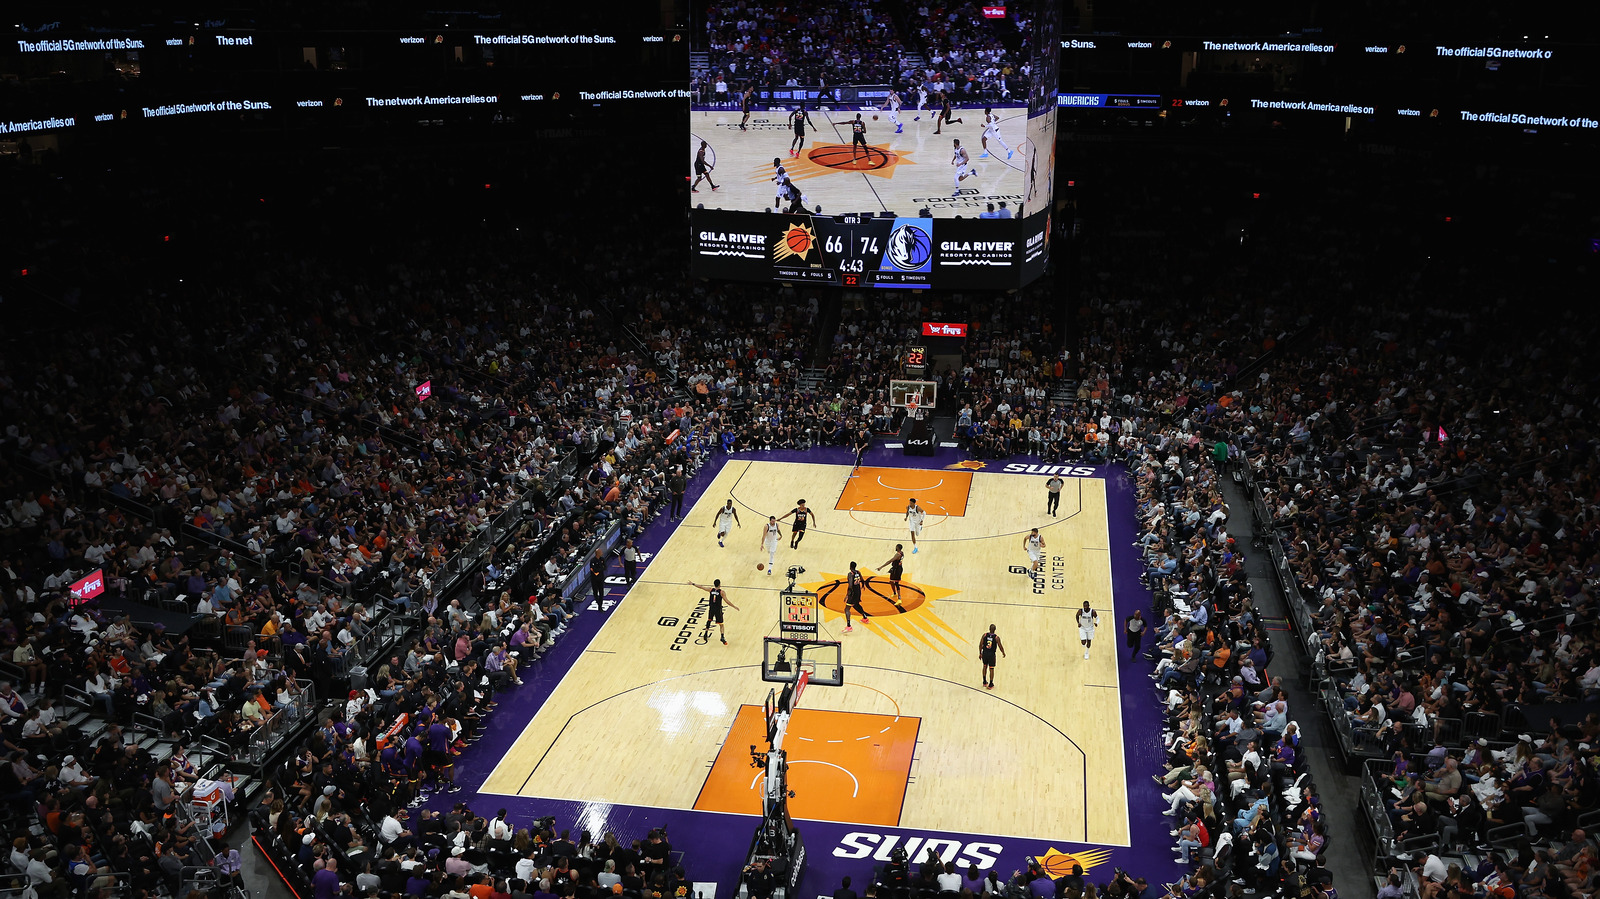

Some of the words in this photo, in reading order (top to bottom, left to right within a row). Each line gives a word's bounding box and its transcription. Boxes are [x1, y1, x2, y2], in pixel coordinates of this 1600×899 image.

[18, 41, 35, 52] The
[36, 40, 62, 51] official
[63, 40, 75, 51] 5G
[75, 39, 105, 50] network
[106, 39, 113, 49] of
[114, 39, 125, 49] the
[126, 38, 144, 48] Suns.
[216, 36, 234, 45] The
[474, 35, 491, 44] The
[492, 35, 521, 44] official
[522, 35, 534, 44] 5G
[536, 35, 569, 43] network
[570, 35, 579, 43] of
[580, 35, 593, 43] the
[594, 35, 616, 43] Suns.
[1071, 40, 1096, 48] Suns.
[1203, 42, 1221, 50] The
[1222, 42, 1261, 50] network
[1262, 42, 1300, 51] America
[1302, 43, 1322, 52] relies
[1436, 47, 1453, 56] The
[1454, 47, 1486, 57] official
[1487, 48, 1501, 57] 5G
[1502, 49, 1543, 58] network
[366, 98, 384, 106] The
[385, 96, 423, 105] network
[424, 96, 461, 104] America
[462, 95, 485, 103] relies
[596, 91, 621, 99] official
[623, 90, 634, 98] 5G
[635, 90, 666, 98] network
[142, 108, 155, 117] The
[156, 105, 176, 116] official
[176, 104, 186, 114] 5G
[186, 102, 216, 113] network
[217, 101, 225, 110] of
[226, 101, 242, 110] the
[243, 100, 271, 109] Suns.
[1251, 100, 1268, 108] The
[1270, 101, 1306, 109] network
[1307, 102, 1340, 112] America
[1341, 104, 1362, 113] relies
[95, 113, 113, 121] verizon
[1461, 111, 1478, 121] The
[1479, 113, 1511, 123] official
[1511, 114, 1526, 123] 5G
[1527, 116, 1568, 126] network
[1570, 118, 1581, 127] of
[1582, 118, 1598, 128] the
[9, 120, 43, 132] America
[43, 117, 65, 128] relies
[65, 118, 75, 126] on
[844, 216, 856, 224] QTR
[700, 231, 727, 241] GILA
[728, 233, 765, 244] RIVER
[825, 235, 842, 253] 66
[861, 237, 878, 255] 74
[940, 241, 971, 251] GILA
[973, 242, 1012, 251] RIVER
[839, 259, 863, 272] 4:43
[908, 353, 923, 363] 22
[1051, 555, 1064, 590] CENTER
[670, 597, 709, 651] FOOTPRINT
